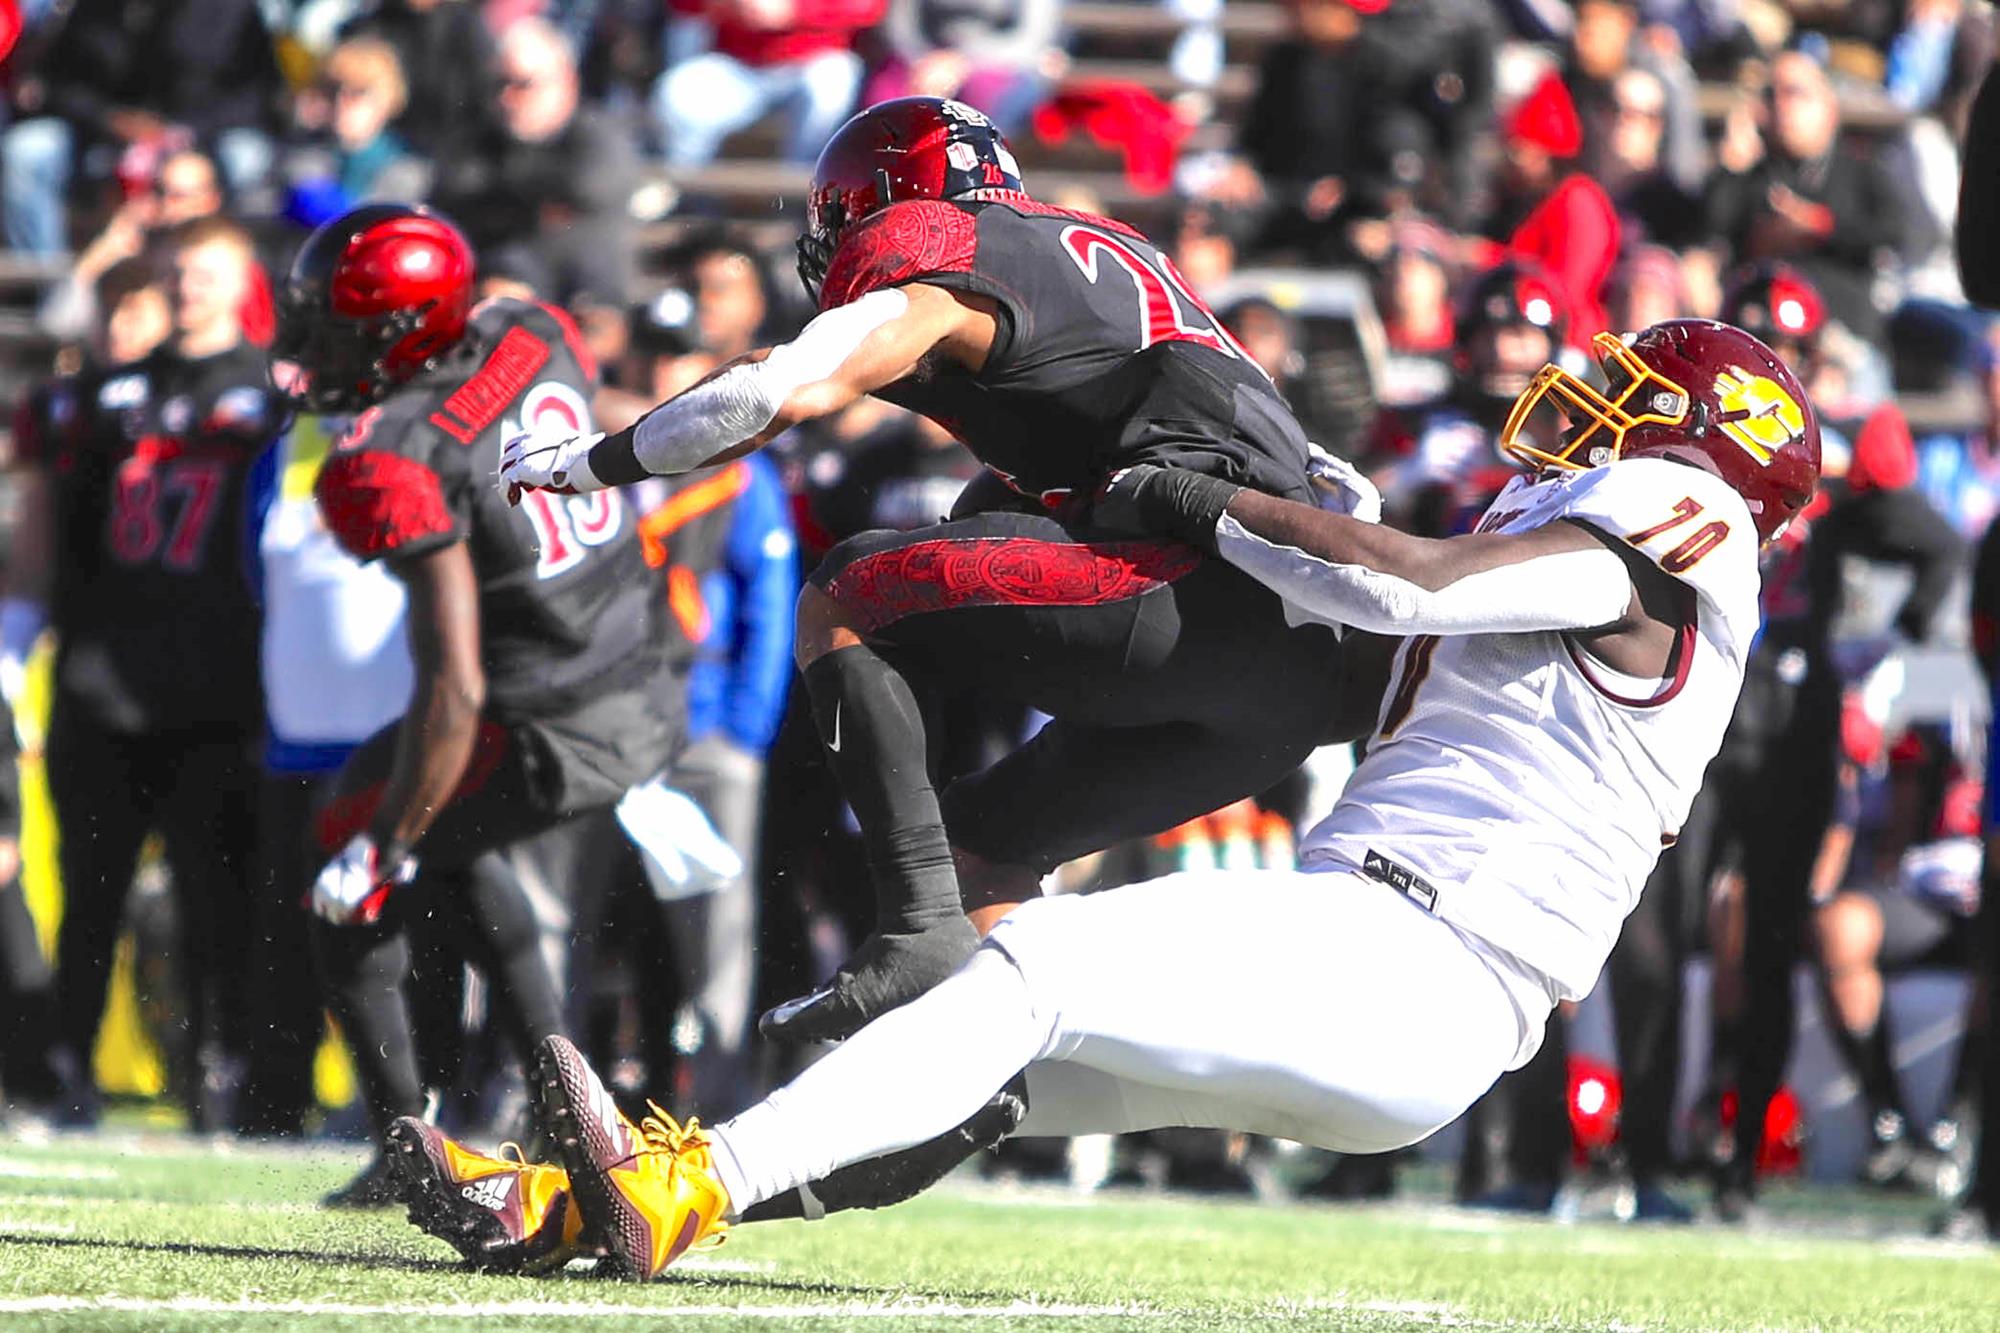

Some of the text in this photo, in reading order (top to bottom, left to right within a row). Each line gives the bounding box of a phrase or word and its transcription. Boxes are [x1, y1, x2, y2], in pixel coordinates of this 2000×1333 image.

[981, 161, 1004, 186] 26
[111, 458, 219, 570] 87
[1624, 495, 1732, 575] 70
[461, 1185, 507, 1211] adidas
